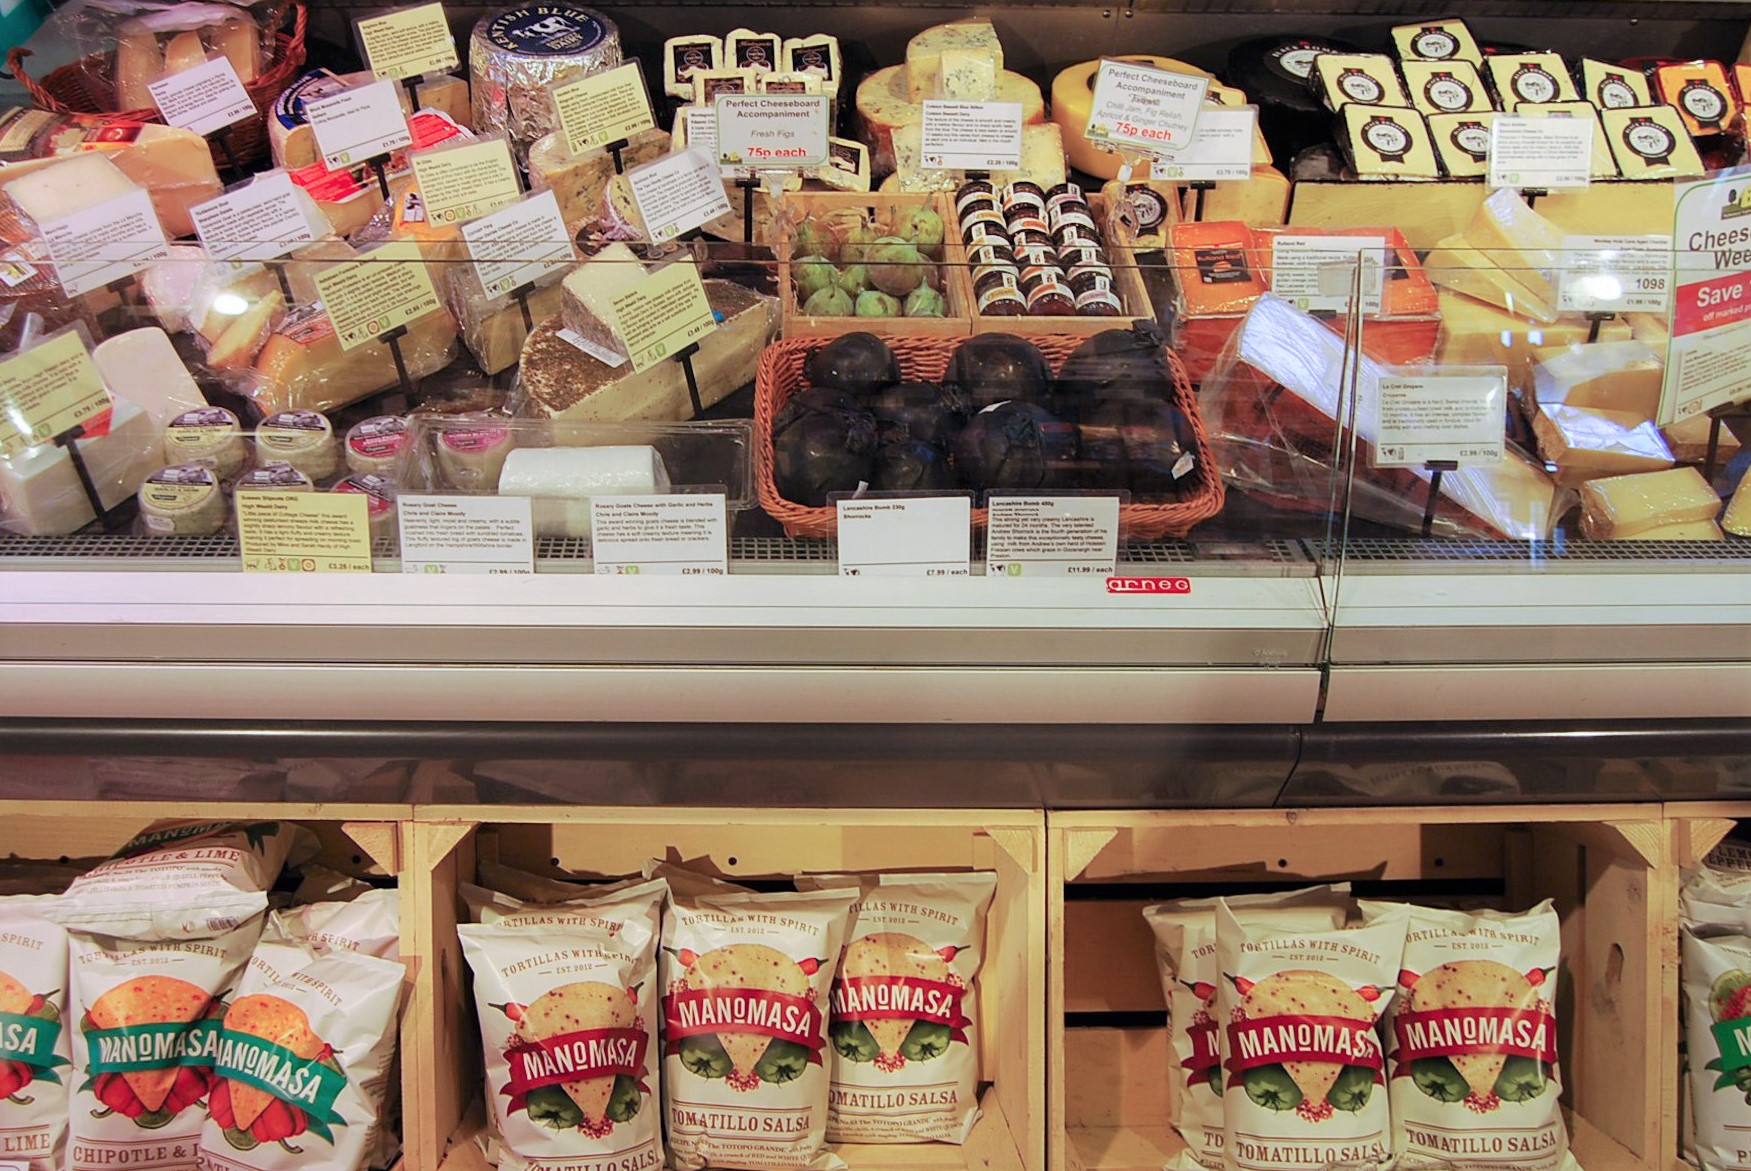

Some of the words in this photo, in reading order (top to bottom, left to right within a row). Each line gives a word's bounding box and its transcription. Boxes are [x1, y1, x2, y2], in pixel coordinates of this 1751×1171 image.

[492, 9, 530, 50] KENTISH
[537, 7, 589, 23] BLUE
[1108, 69, 1139, 79] Perfect
[1141, 74, 1198, 90] Cheeseboard
[1116, 82, 1185, 100] Accompaniment
[1106, 101, 1124, 110] Chilli
[1145, 107, 1157, 117] Fig
[1097, 110, 1123, 120] Apricot
[1132, 115, 1156, 126] Ginger
[1158, 120, 1187, 131] Chutney
[1116, 122, 1138, 136] 75p
[1142, 129, 1171, 140] each
[748, 148, 770, 159] 75p
[776, 148, 806, 156] each
[1714, 249, 1751, 270] Wee
[1636, 278, 1665, 289] 1098
[1697, 285, 1743, 308] Save
[1703, 312, 1715, 322] off
[1716, 306, 1743, 319] marked
[175, 851, 189, 859] &
[194, 849, 240, 862] LIME
[557, 917, 587, 926] WITH
[849, 902, 887, 914] TILLAS
[889, 902, 918, 914] WITH
[919, 906, 959, 926] SPIRIT
[889, 916, 906, 924] 2012
[681, 914, 744, 928] TORTILLAS
[747, 914, 778, 925] WITH
[779, 918, 820, 937] SPIRIT
[747, 927, 765, 935] 2012
[1470, 942, 1489, 950] 2012
[1500, 930, 1540, 946] SPIRIT
[149, 944, 182, 961] WITH
[184, 943, 228, 959] SPIRIT
[1240, 940, 1306, 953] TORTILLAS
[1309, 940, 1338, 952] WITH
[1341, 943, 1382, 964] SPIRIT
[501, 951, 568, 978] TORTILLAS
[571, 949, 603, 961] WITH
[574, 963, 593, 972] 2012
[677, 996, 812, 1038] MANOMASA
[1405, 1015, 1547, 1052] MANOMASA
[523, 1039, 637, 1080] MANOMASA
[829, 1092, 906, 1109] OMATILLO
[909, 1088, 958, 1106] SALSA
[672, 1109, 759, 1132] TOMATILLO
[762, 1114, 811, 1133] SALSA
[3, 1133, 51, 1150] LIME
[1405, 1128, 1502, 1153] TOMATILLO
[1507, 1131, 1557, 1152] SALSA
[73, 1144, 168, 1163] CHIPOTLE
[172, 1145, 187, 1158] &
[1236, 1141, 1337, 1164] TOMATILLO
